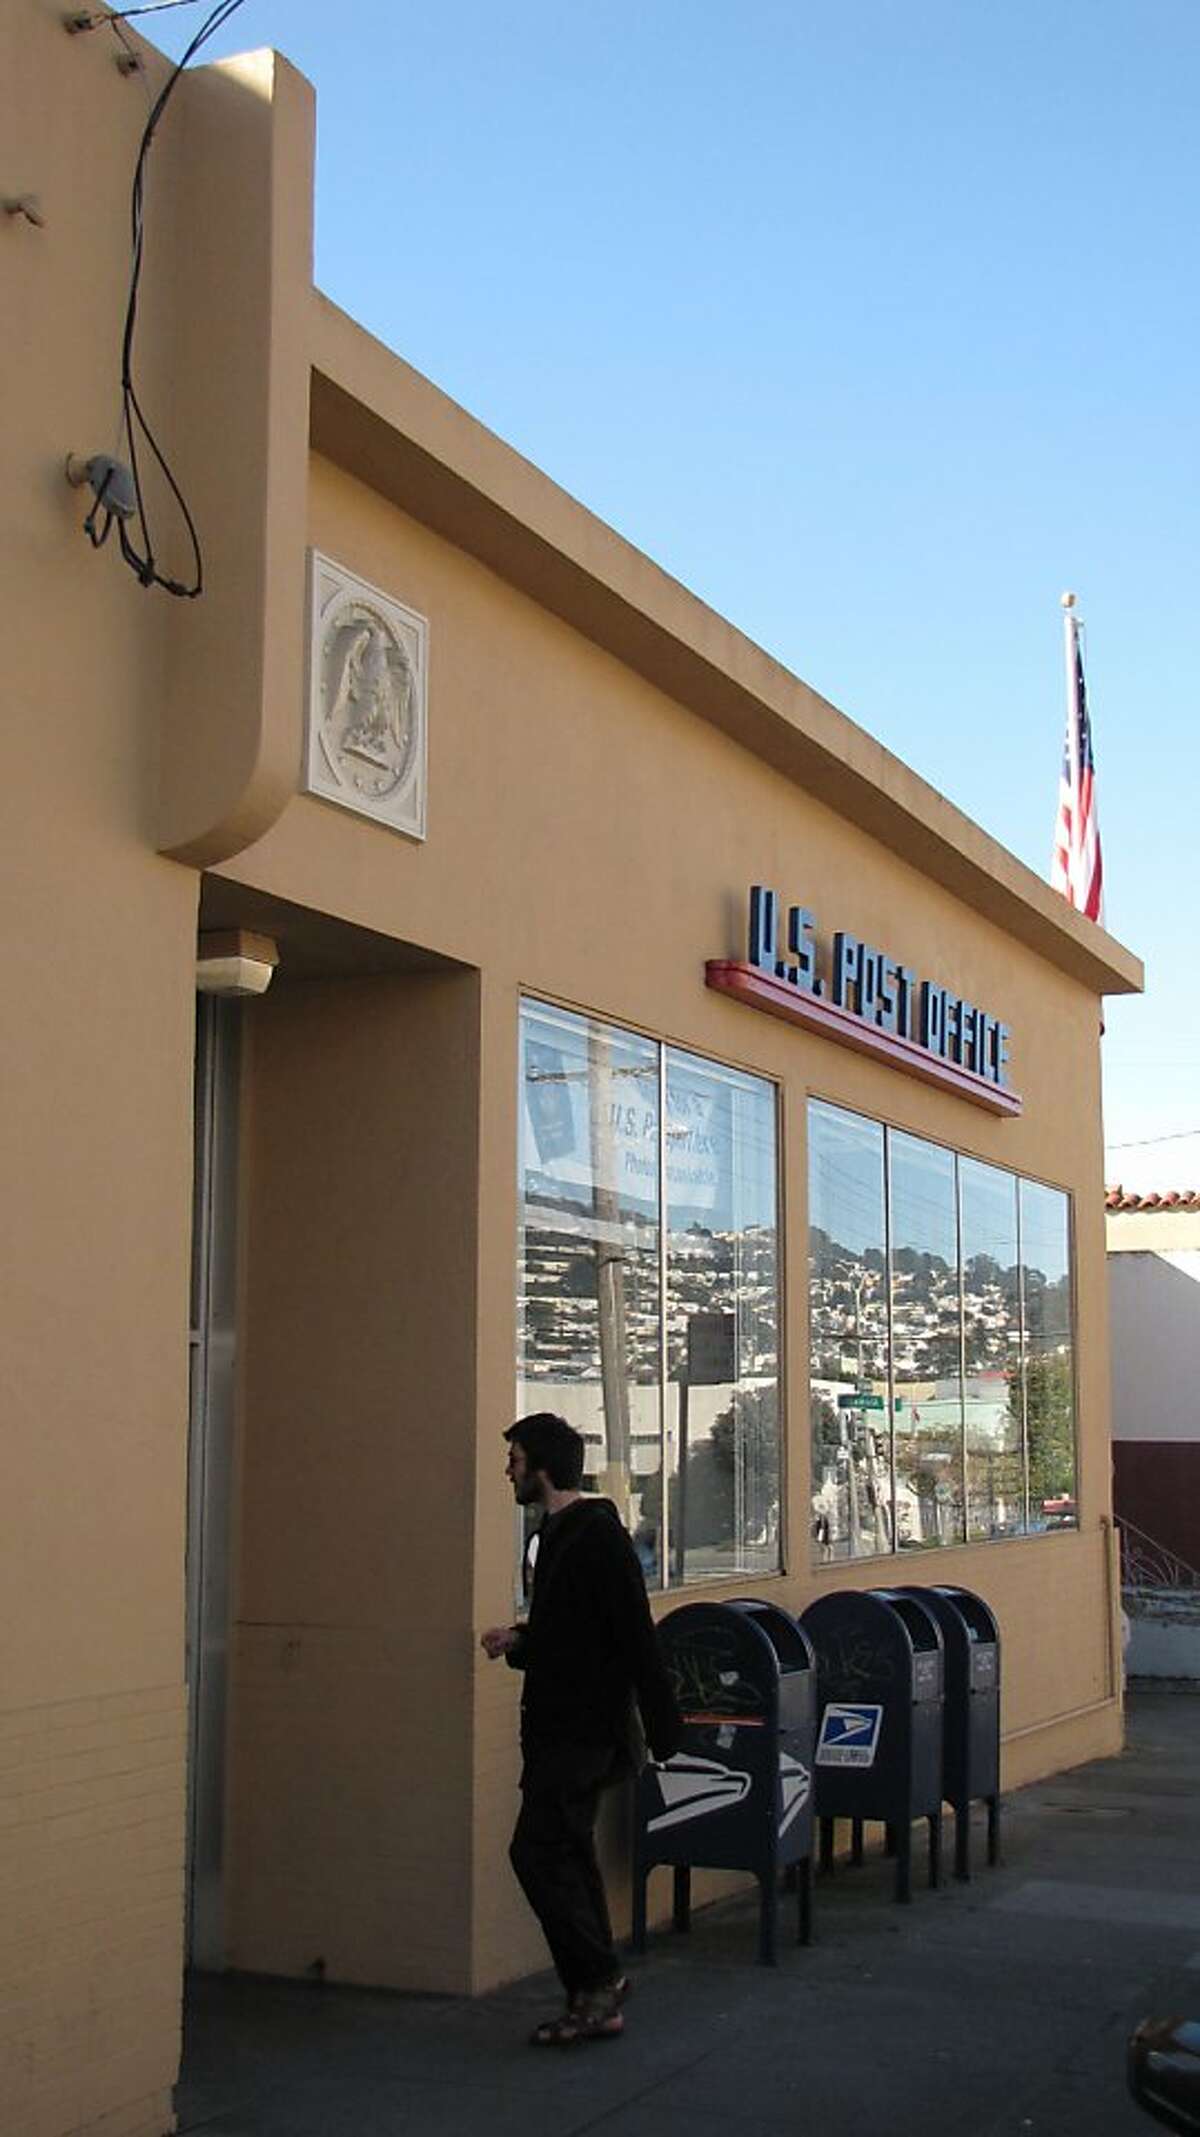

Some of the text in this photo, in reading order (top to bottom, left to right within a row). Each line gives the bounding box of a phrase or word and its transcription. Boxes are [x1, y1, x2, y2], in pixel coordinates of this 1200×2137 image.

[749, 885, 1011, 1086] U.S. POST OFFICE
